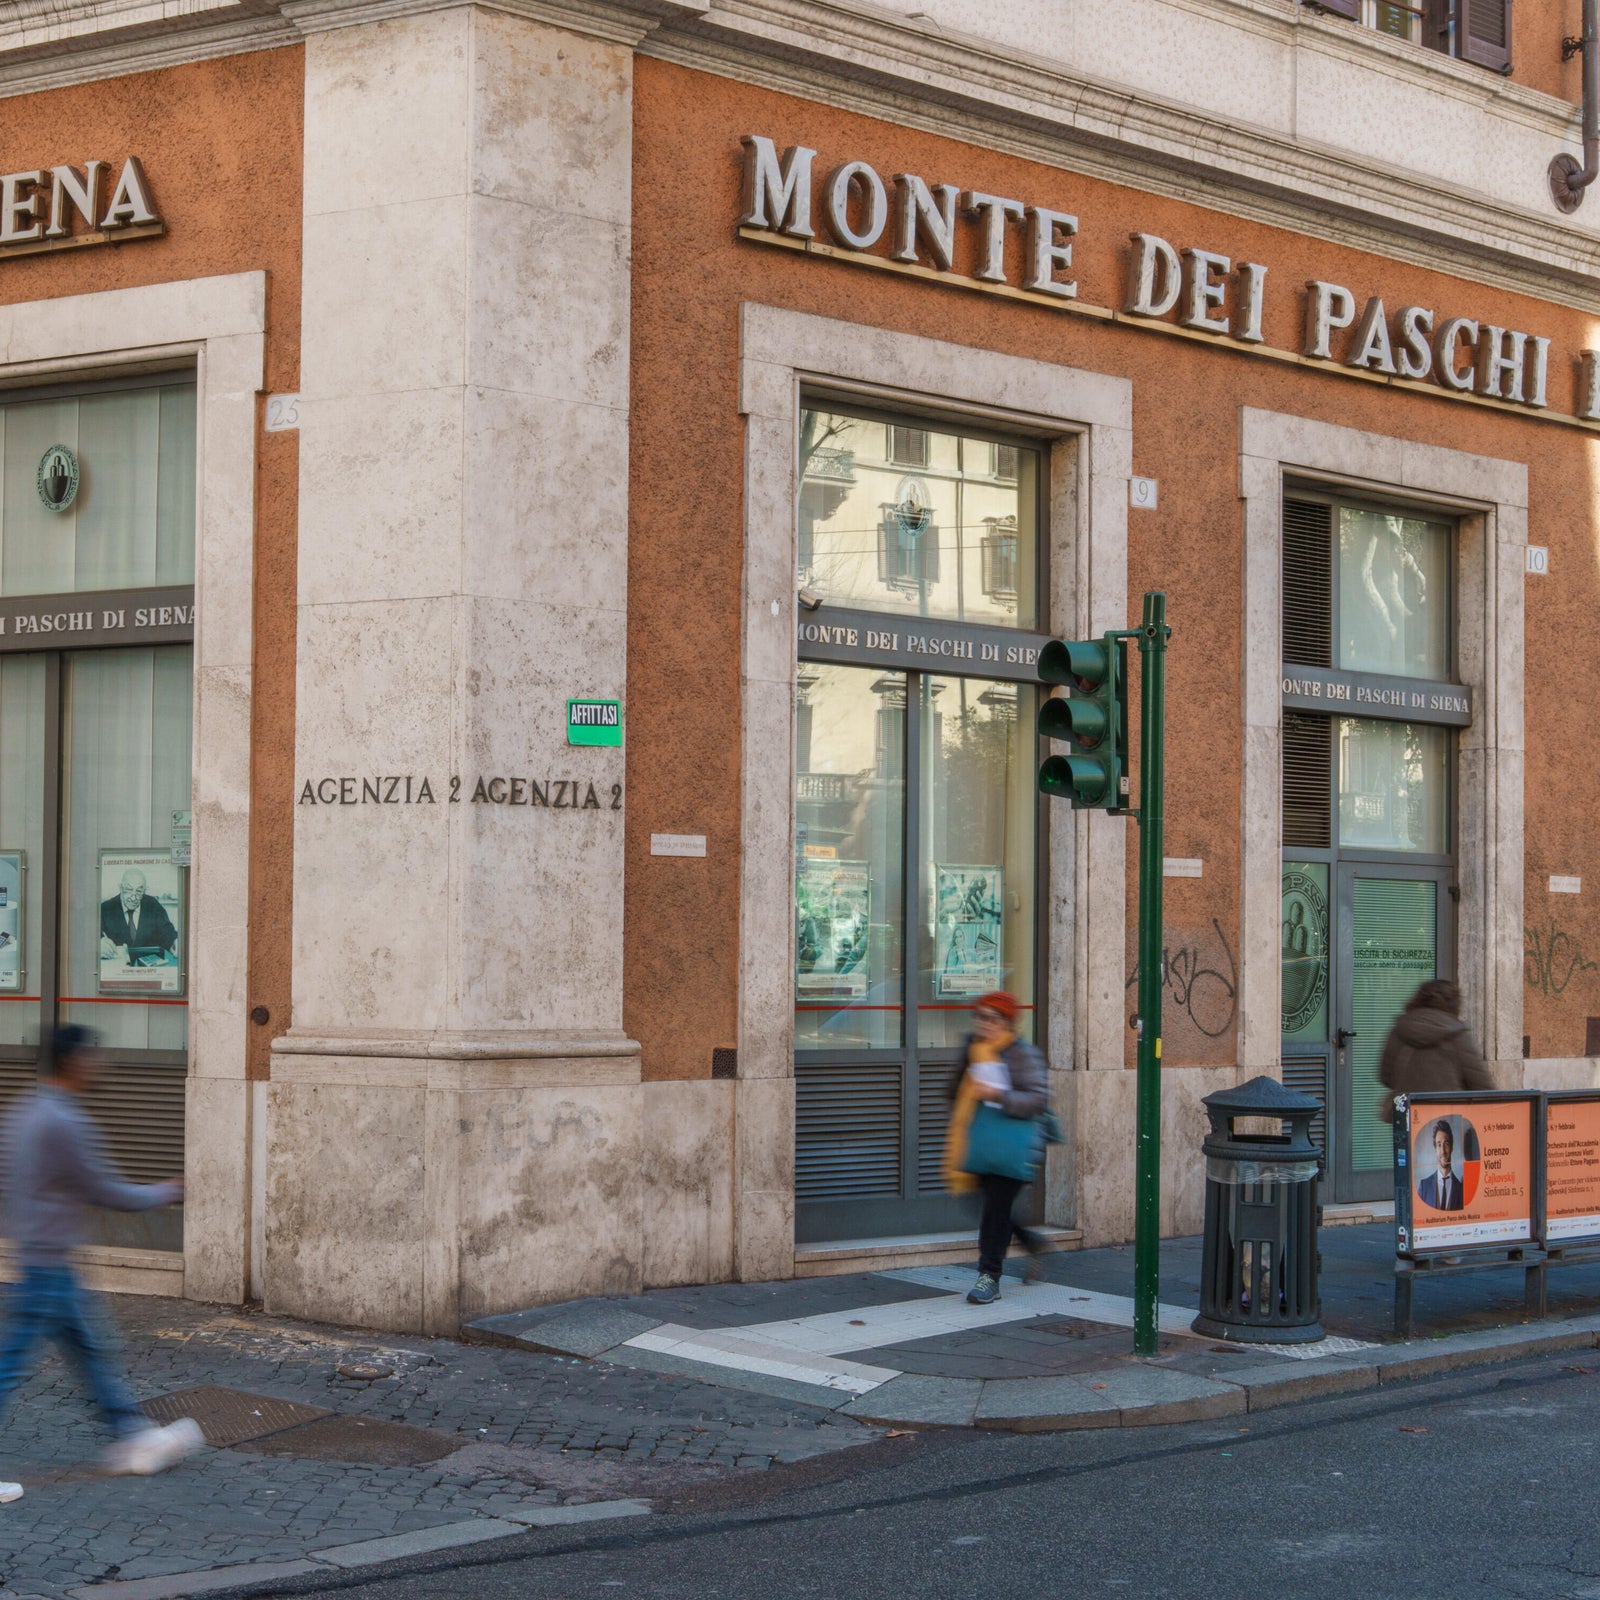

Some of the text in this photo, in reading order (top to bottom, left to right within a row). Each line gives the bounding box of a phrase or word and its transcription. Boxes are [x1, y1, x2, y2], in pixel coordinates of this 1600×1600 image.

[740, 135, 1079, 299] MONTE
[1124, 232, 1268, 343] DEI
[1304, 280, 1551, 408] PASCHI
[270, 399, 299, 427] 25
[1136, 480, 1149, 504] 9
[1529, 549, 1545, 571] 10
[14, 612, 94, 634] PASCHI
[102, 610, 126, 629] DI
[866, 630, 899, 651] DEI
[906, 634, 974, 659] PASCHI
[980, 643, 1000, 662] DI
[1007, 646, 1042, 666] SIE
[1326, 682, 1351, 701] DEI
[1356, 686, 1407, 707] PASCHI
[1412, 693, 1426, 709] DI
[1431, 695, 1470, 714] SIENA
[570, 703, 618, 725] AFFITTASI
[298, 774, 461, 805] AGENZIA 2
[470, 775, 623, 811] AGENZIA 2
[1354, 950, 1433, 960] USCITA DI SICUREZZA
[1484, 1147, 1510, 1157] Lorenzo
[1484, 1160, 1502, 1171] Viotti
[1484, 1186, 1511, 1198] Sinfonia
[1519, 1187, 1525, 1198] 5
